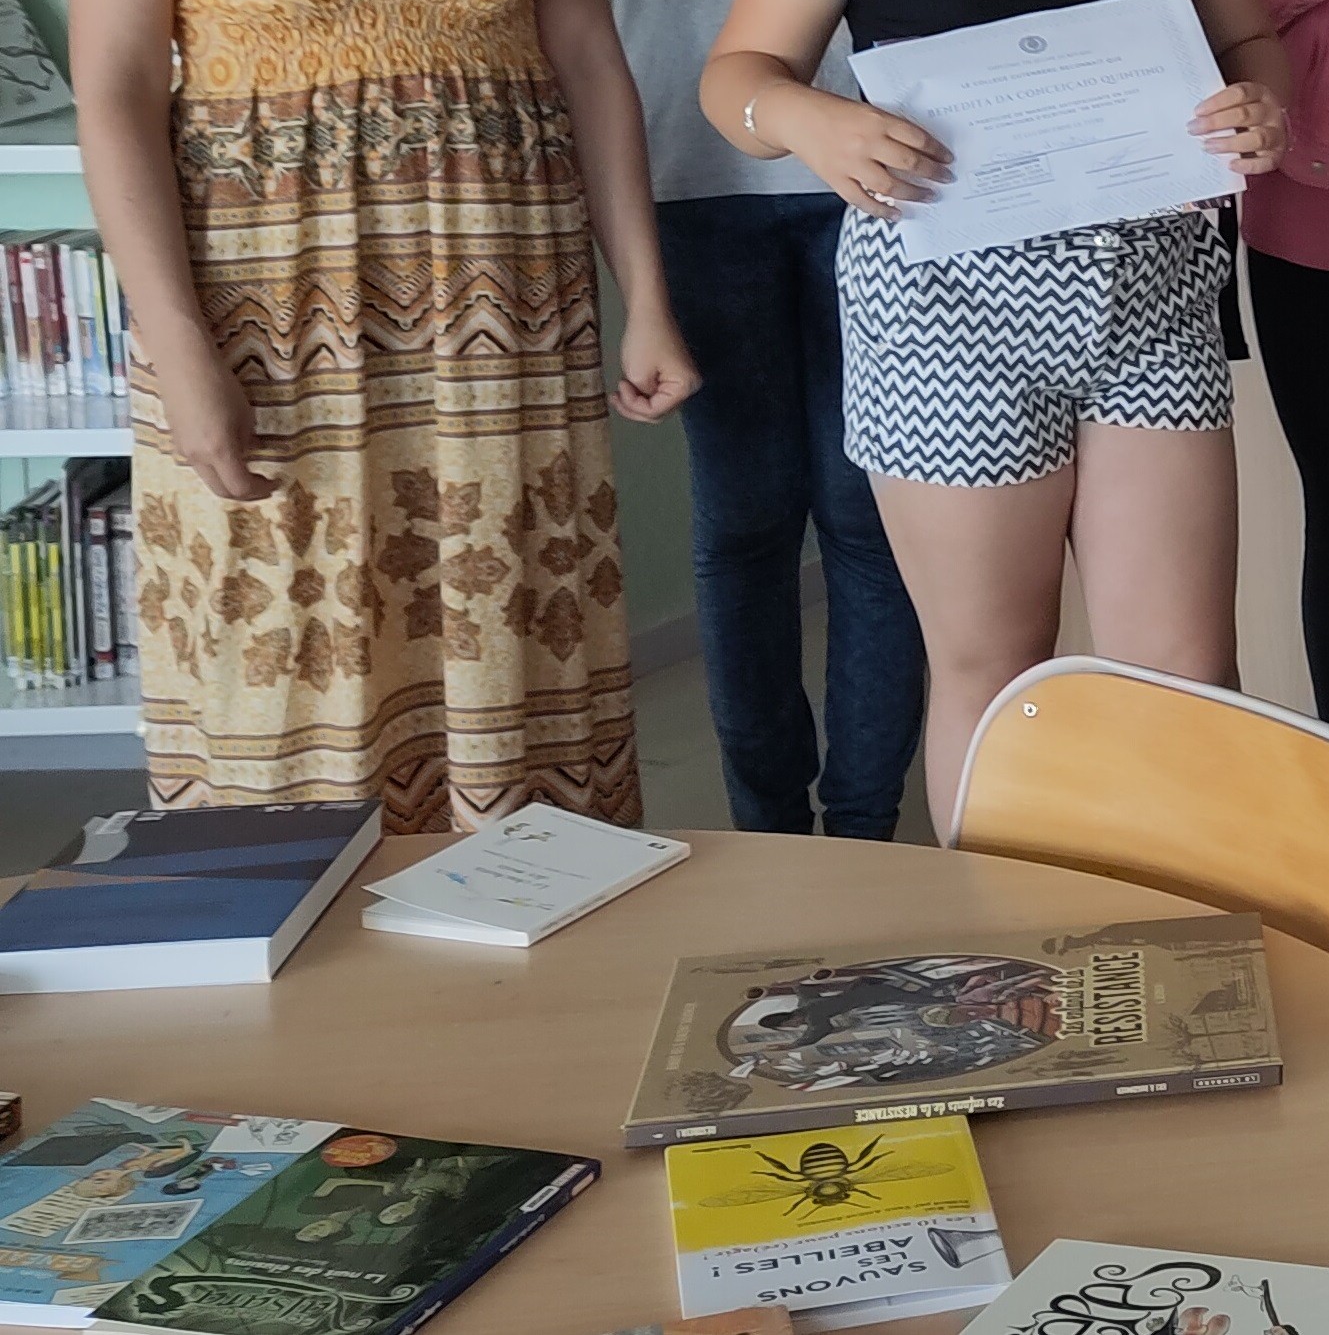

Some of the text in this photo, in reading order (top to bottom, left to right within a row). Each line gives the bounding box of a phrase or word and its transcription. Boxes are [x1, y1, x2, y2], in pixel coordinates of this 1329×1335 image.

[928, 97, 992, 118] BENEDITA
[996, 91, 1015, 105] DA
[1099, 65, 1166, 85] QUINTINO
[919, 1104, 932, 1117] la
[932, 1103, 946, 1116] de
[947, 1097, 985, 1114] enfants
[987, 1097, 1005, 1110] Les
[917, 1218, 940, 1228] 10
[945, 1216, 976, 1226] Les
[796, 1230, 840, 1247] pour
[845, 1222, 912, 1239] actions
[712, 1236, 913, 1278] ABEILLES !
[857, 1251, 908, 1268] LES
[757, 1260, 928, 1303] SAUVONS
